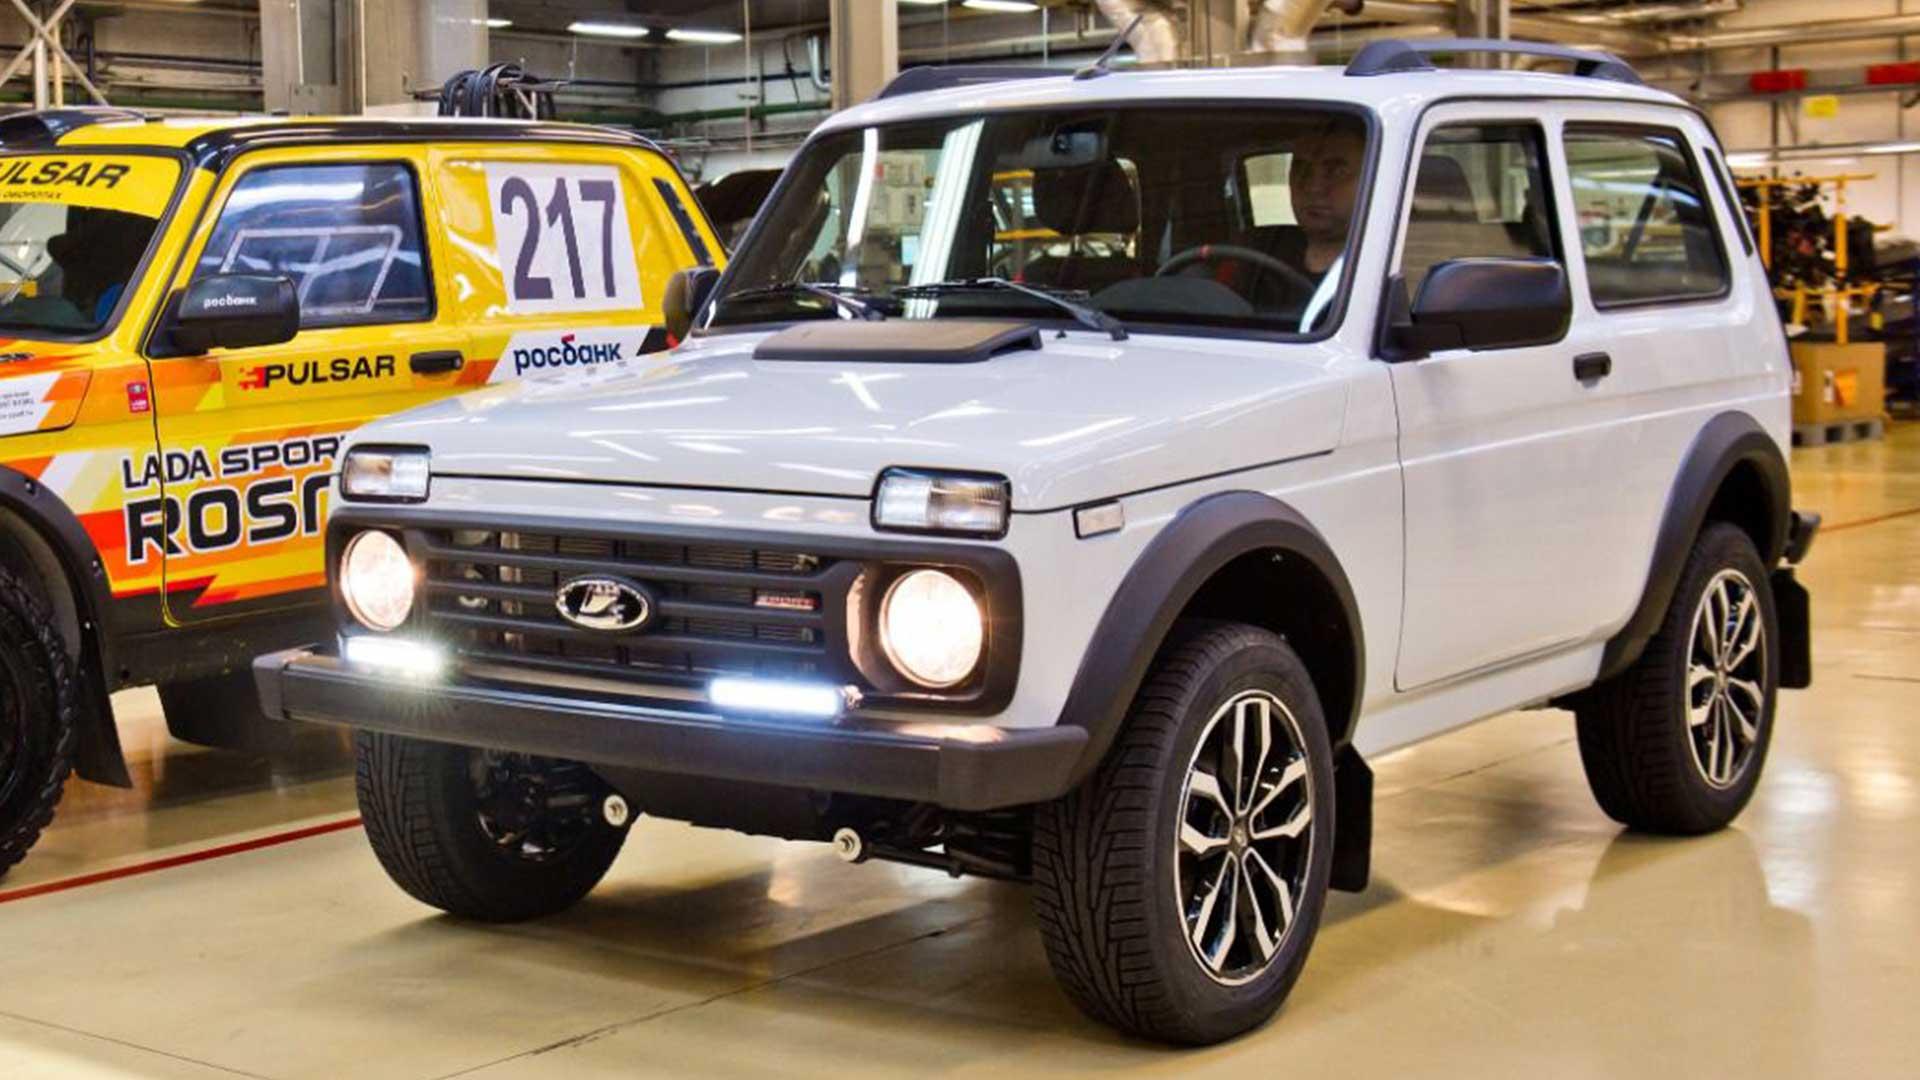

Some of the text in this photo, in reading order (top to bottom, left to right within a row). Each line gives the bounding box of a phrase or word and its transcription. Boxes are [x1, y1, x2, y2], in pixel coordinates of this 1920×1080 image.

[500, 177, 617, 299] 217
[264, 355, 395, 388] PULSAR
[513, 334, 622, 376] росбанк
[123, 434, 346, 489] LADA SPOR
